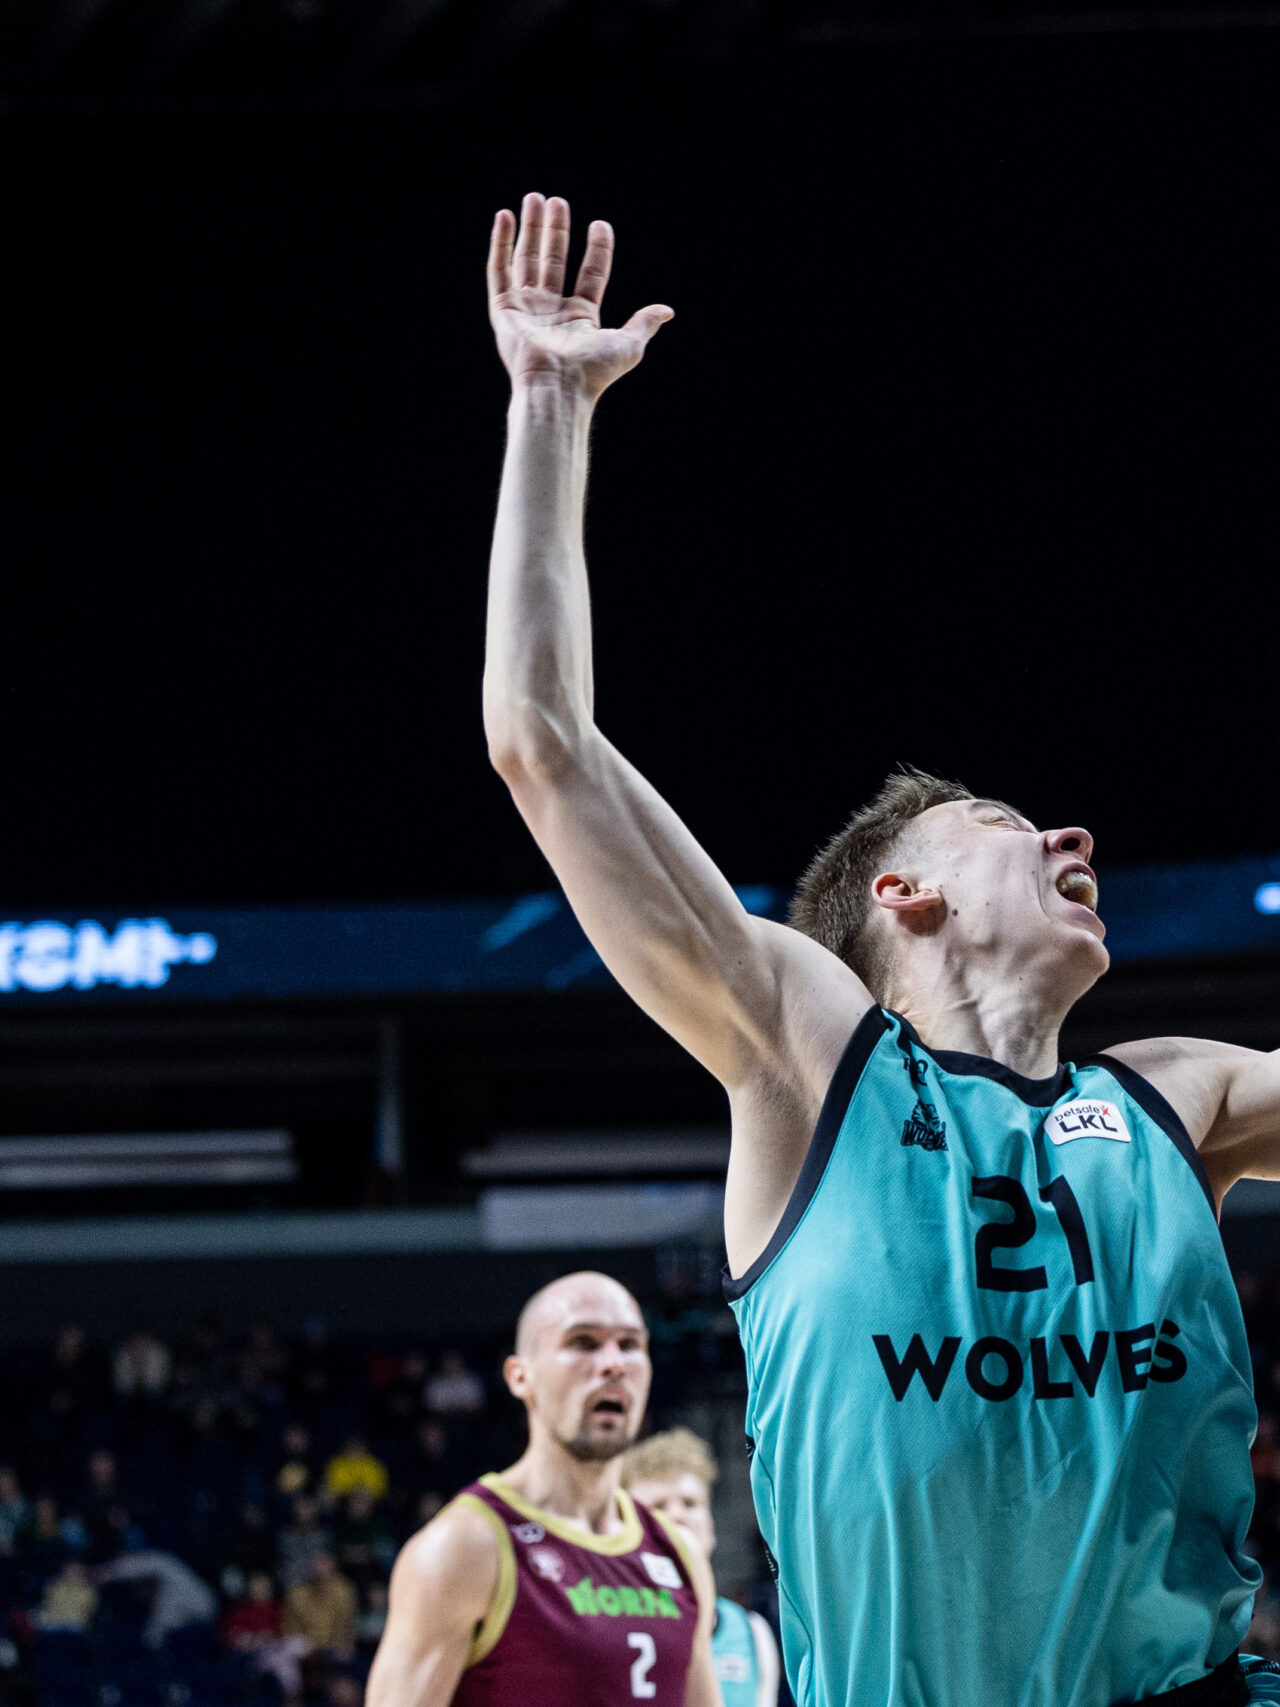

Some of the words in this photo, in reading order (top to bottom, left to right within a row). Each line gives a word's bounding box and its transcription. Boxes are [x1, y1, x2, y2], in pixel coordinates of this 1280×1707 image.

[1054, 1104, 1100, 1123] betsafe
[1059, 1114, 1118, 1133] LKL
[971, 1174, 1096, 1293] 21
[872, 1318, 1188, 1403] WOLVES
[626, 1632, 657, 1699] 2
